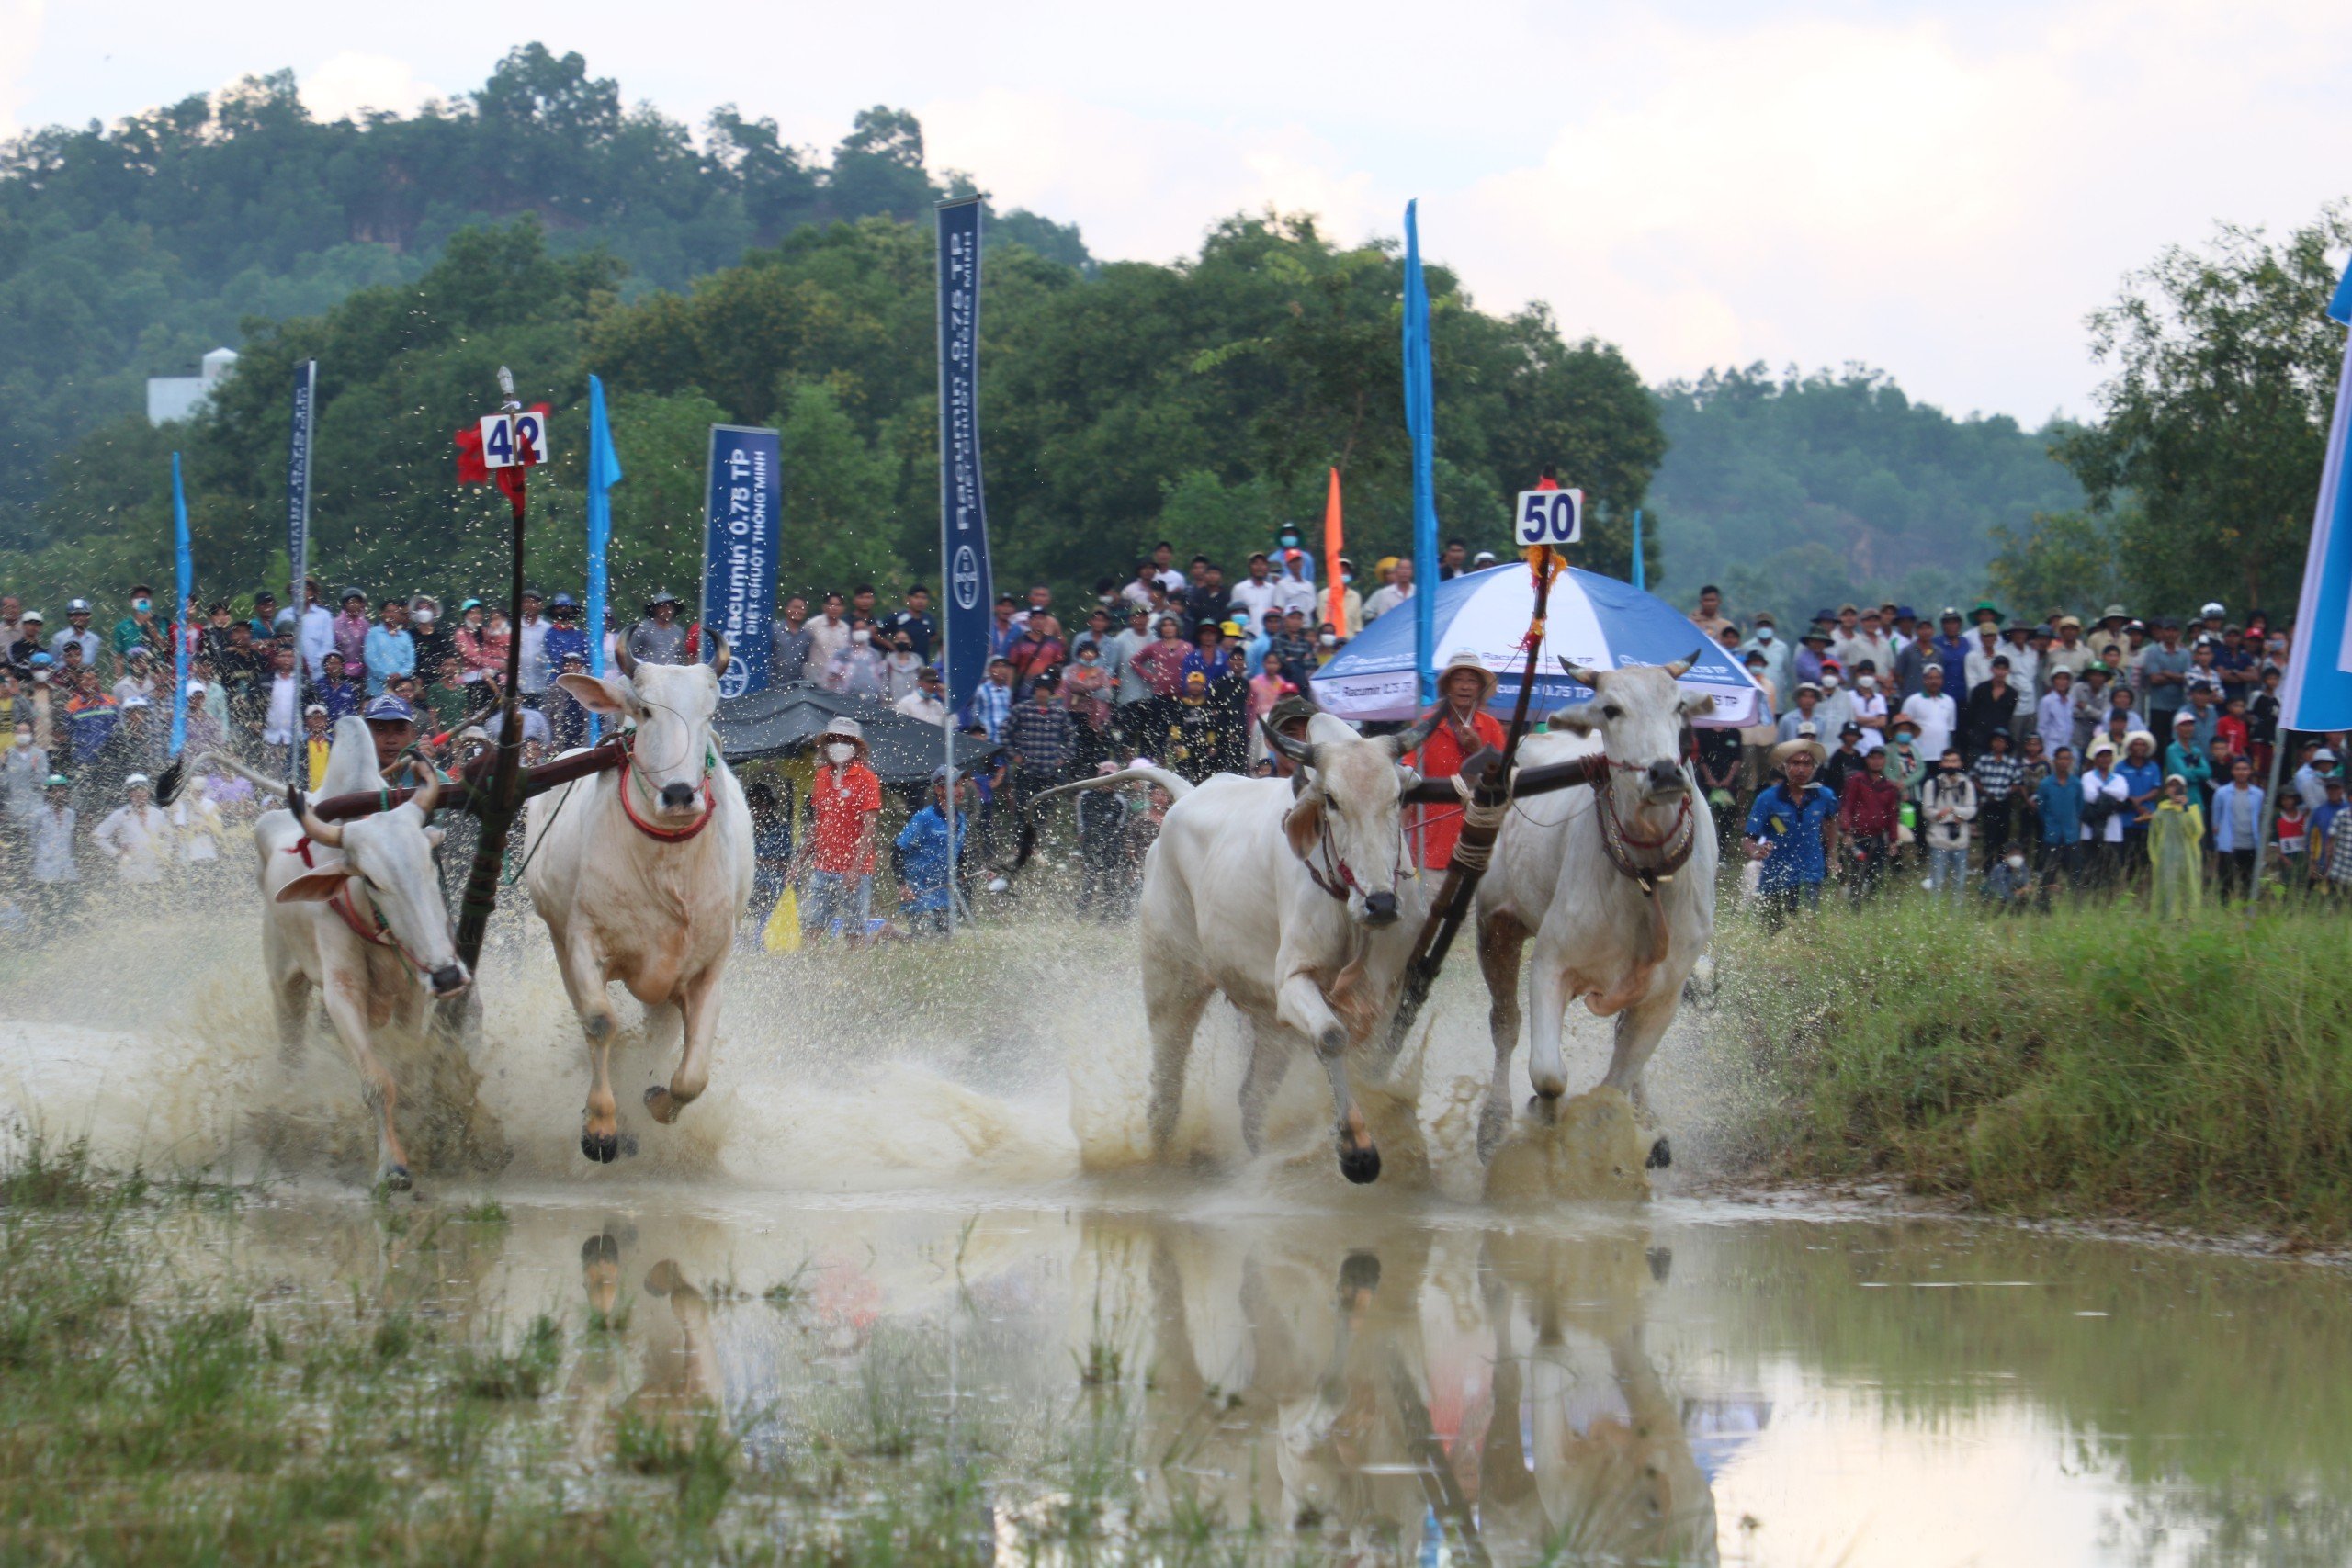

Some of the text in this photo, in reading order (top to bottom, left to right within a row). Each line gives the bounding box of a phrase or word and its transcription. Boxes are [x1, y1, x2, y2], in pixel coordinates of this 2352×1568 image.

[950, 232, 963, 281] TP
[950, 289, 963, 362] 0.75
[487, 416, 541, 464] 42
[753, 450, 767, 489] MINH
[751, 492, 767, 544] THÔNG
[1522, 493, 1575, 543] 50
[722, 448, 751, 647] Racumin 0.75 TP
[1574, 686, 1595, 698] TP
